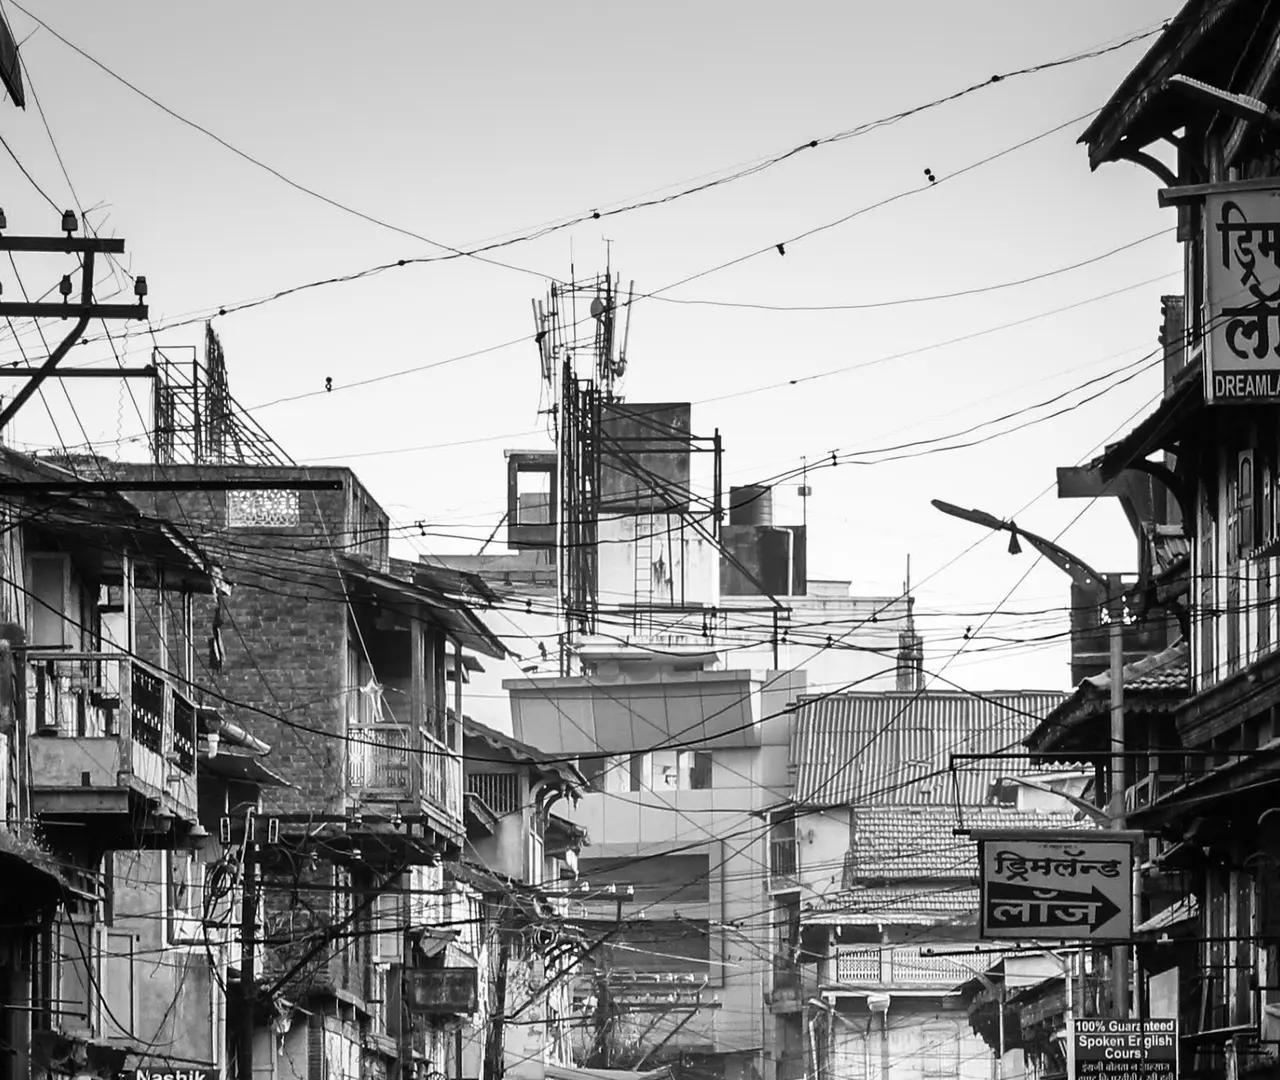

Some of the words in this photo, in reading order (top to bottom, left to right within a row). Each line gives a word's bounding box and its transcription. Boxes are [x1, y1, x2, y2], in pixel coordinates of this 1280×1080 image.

[990, 889, 1103, 924] लॉज
[1075, 1020, 1106, 1032] 100%
[1078, 1034, 1125, 1050] Spoken
